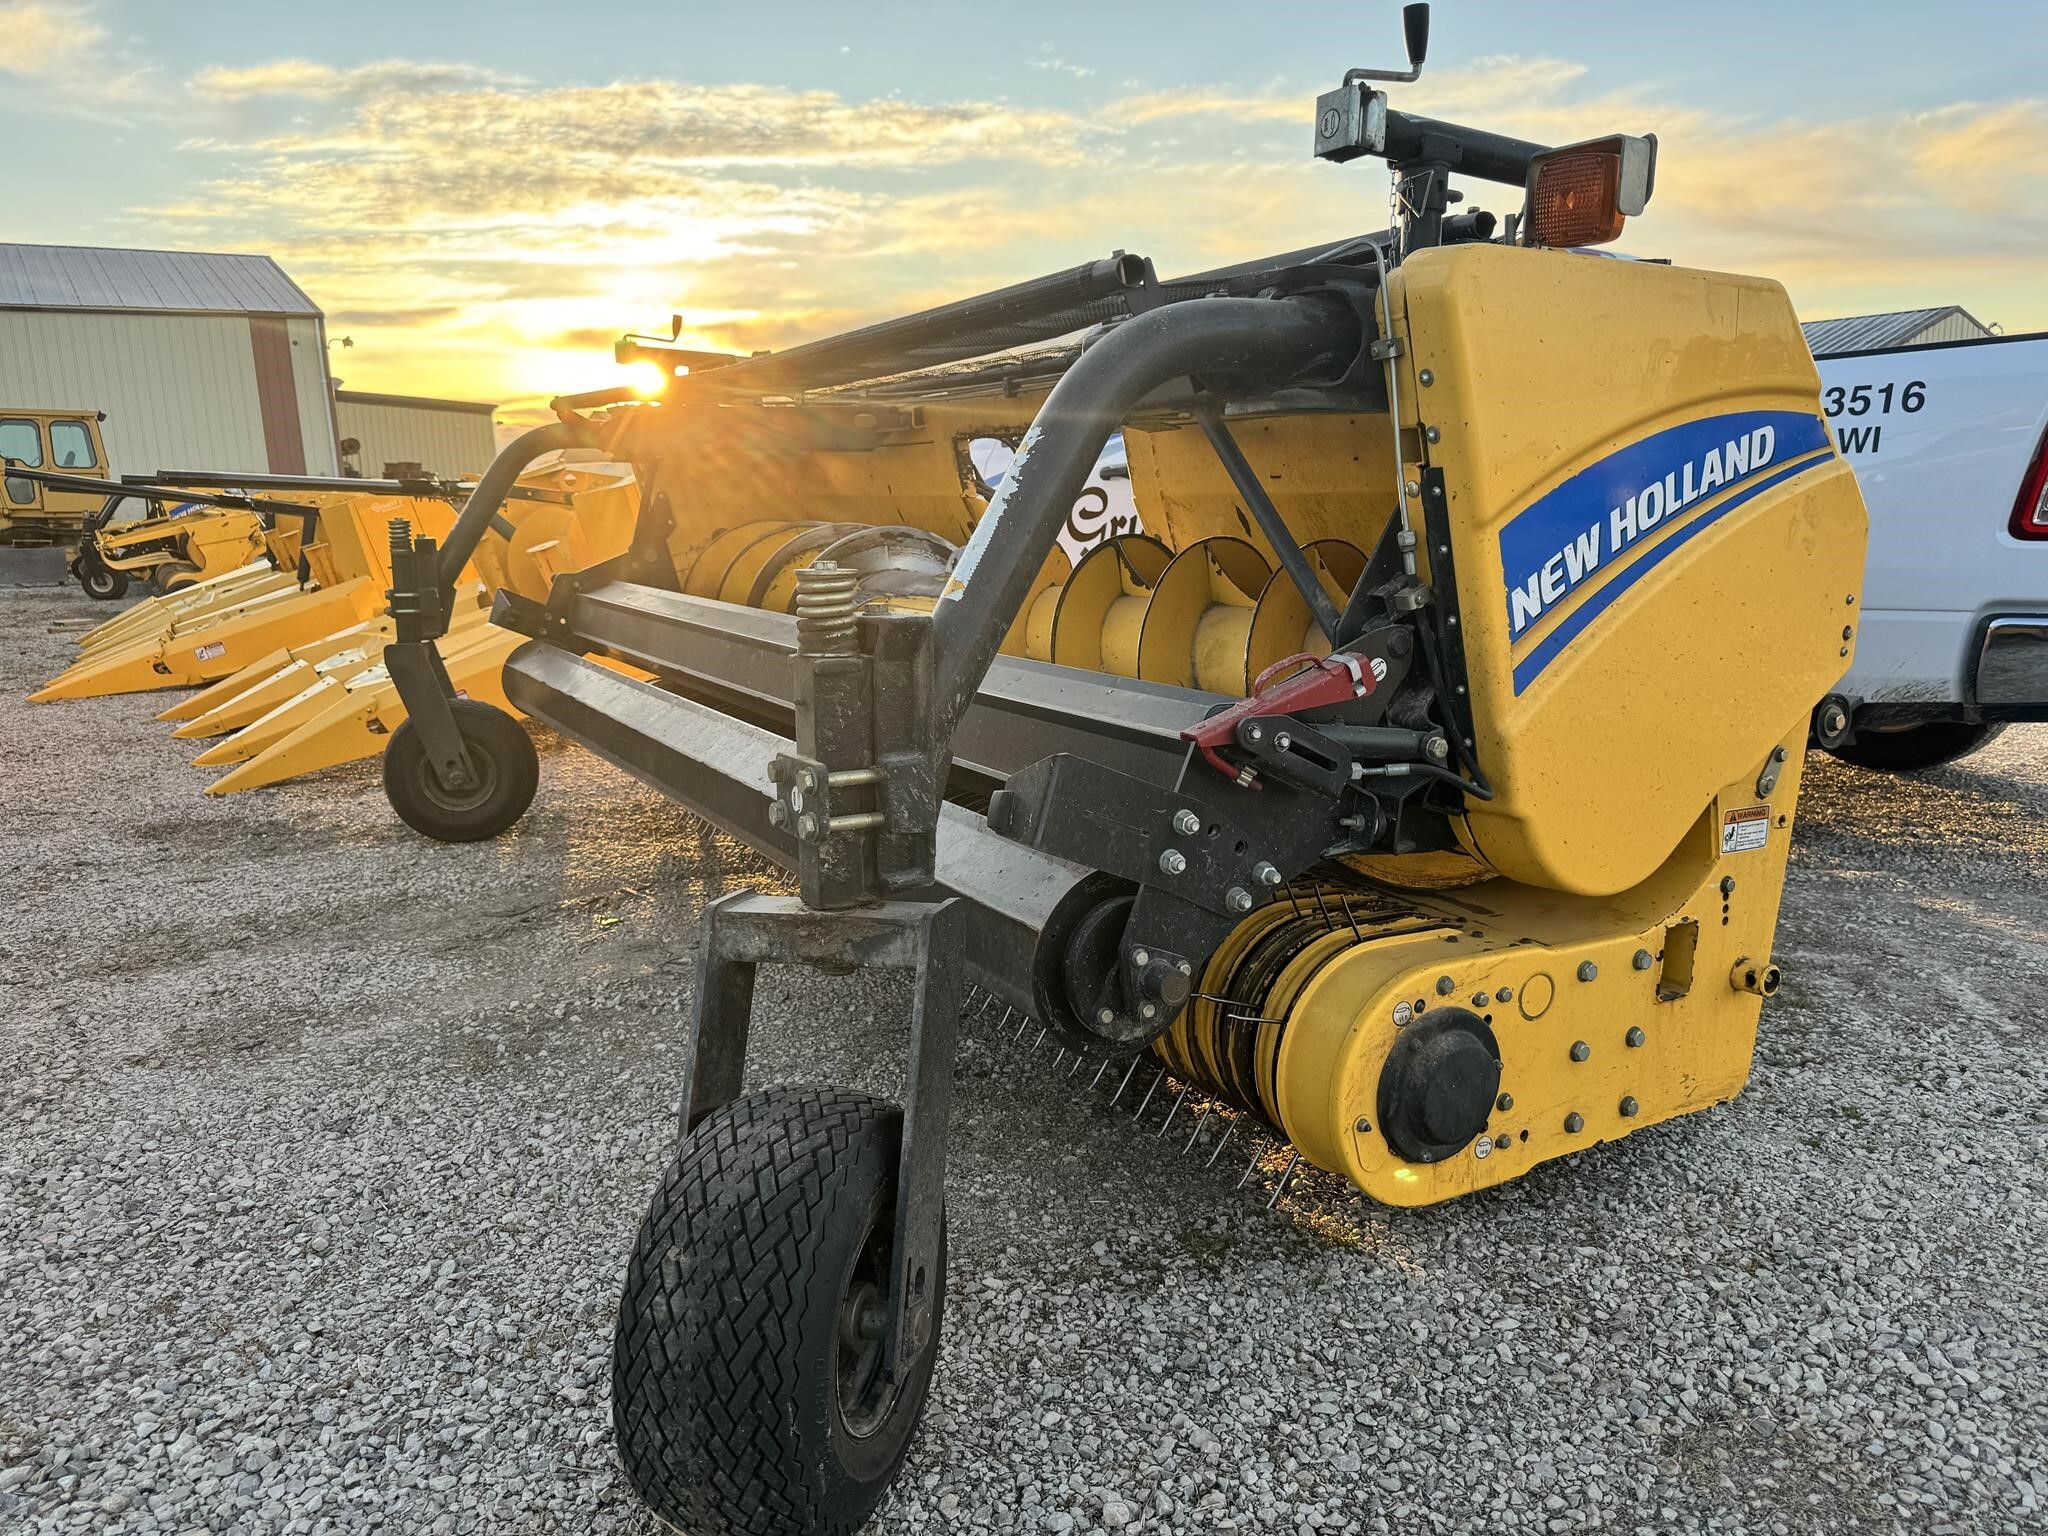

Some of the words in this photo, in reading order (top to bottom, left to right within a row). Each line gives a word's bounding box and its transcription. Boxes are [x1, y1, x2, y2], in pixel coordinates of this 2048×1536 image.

[1823, 381, 1927, 418] 3516
[1838, 426, 1882, 454] WI
[1511, 521, 1600, 633] NEW
[1610, 425, 1775, 553] HOLLAND
[1737, 809, 1766, 820] WARNING
